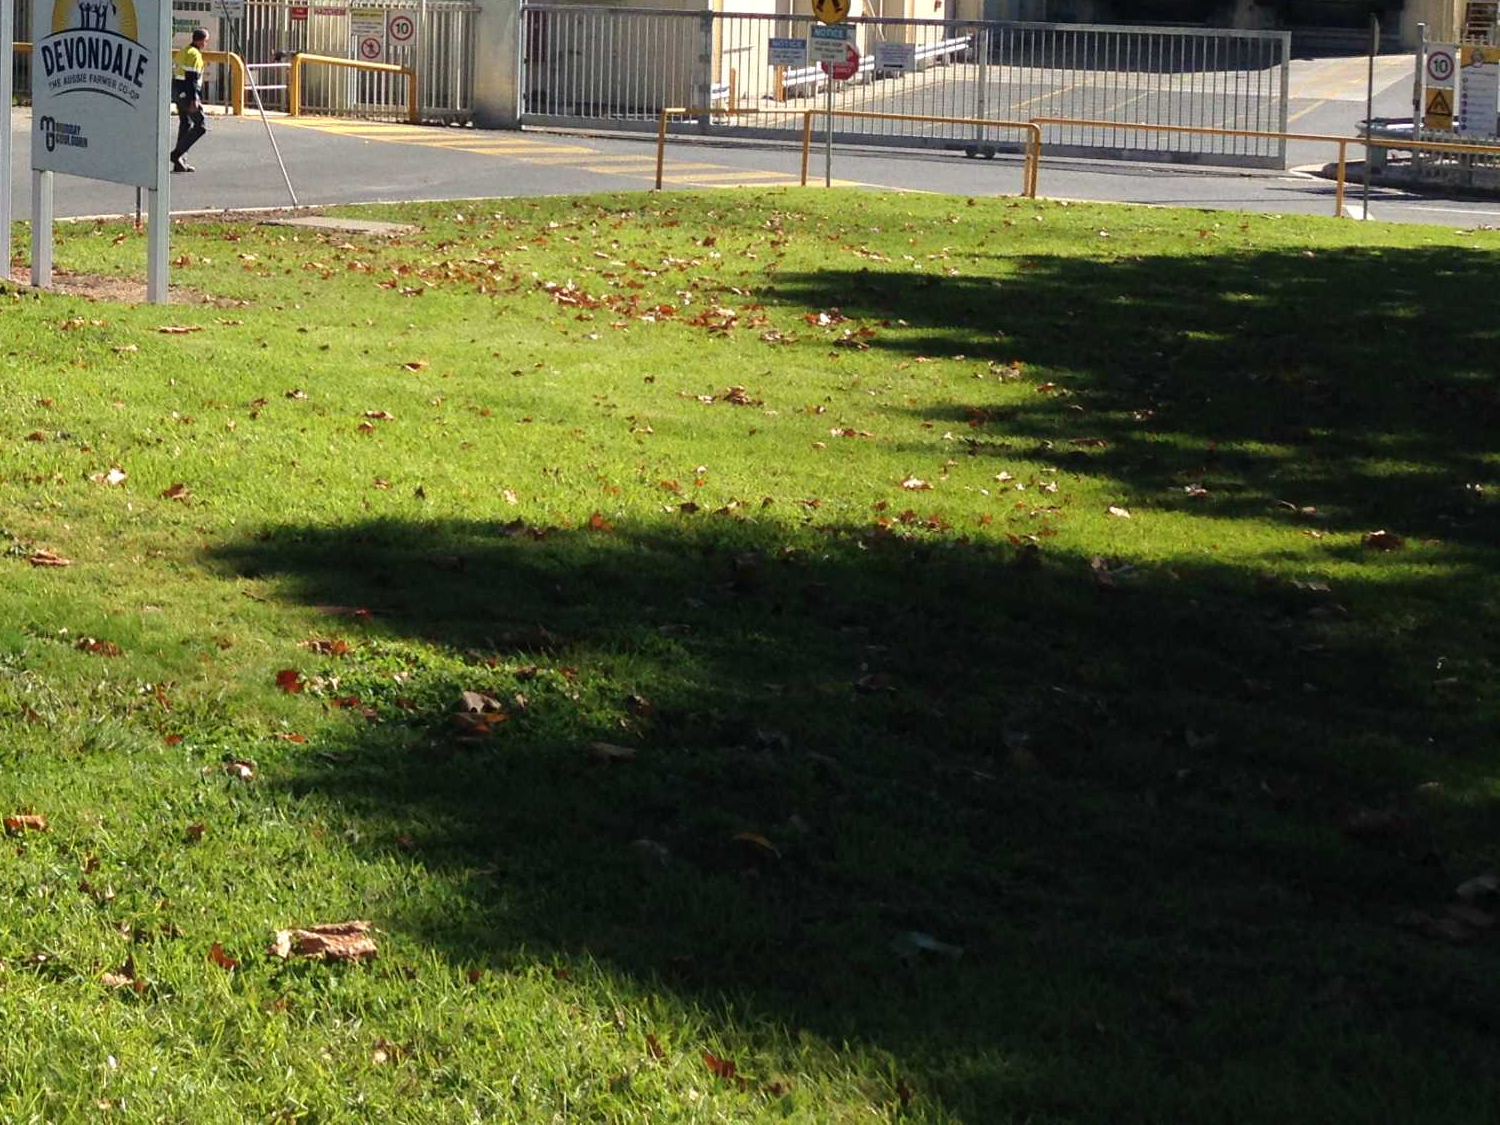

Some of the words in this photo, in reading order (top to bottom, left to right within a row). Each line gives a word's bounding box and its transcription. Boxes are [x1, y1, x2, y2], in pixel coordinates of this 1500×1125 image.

[395, 22, 409, 35] 10
[814, 27, 845, 38] NOTICE
[41, 36, 148, 88] DEVONDALE
[1434, 58, 1448, 73] 10
